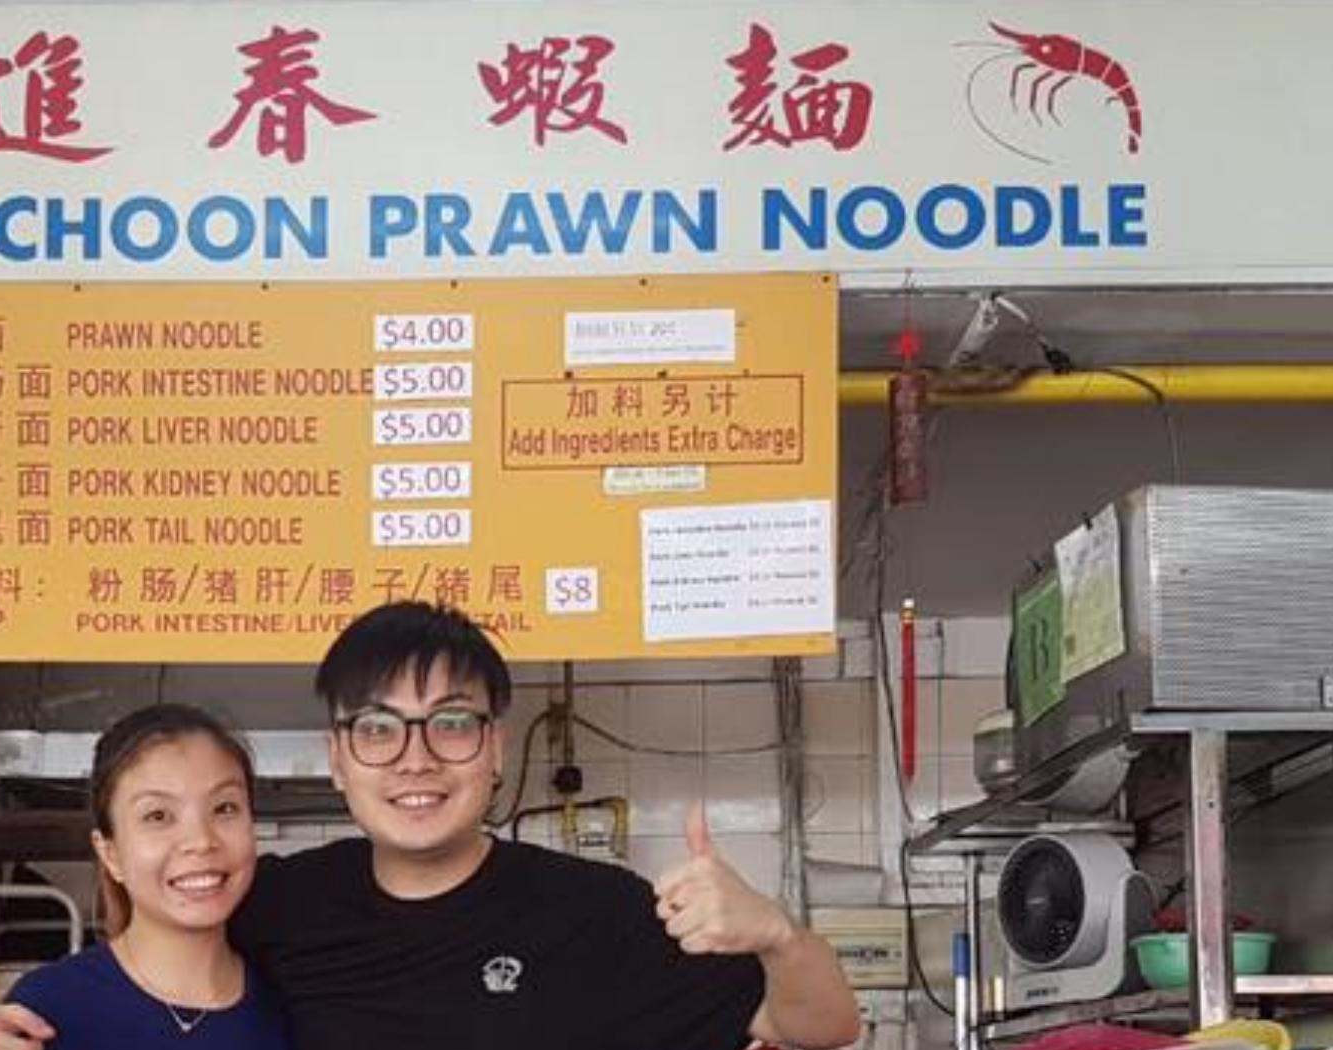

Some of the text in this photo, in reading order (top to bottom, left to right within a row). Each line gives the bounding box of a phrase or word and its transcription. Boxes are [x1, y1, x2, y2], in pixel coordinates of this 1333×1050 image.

[369, 188, 718, 259] PRAWN
[762, 183, 1148, 251] NOODLE
[66, 320, 264, 350] PRAWN NOODLE
[383, 318, 465, 350] $4.00
[67, 367, 374, 399] PORK INTESTINE NOODLE
[383, 365, 466, 396] $5.00
[565, 382, 739, 419] 加料另计
[67, 415, 318, 445] PORK LIVER NOODLE
[380, 412, 464, 443] $5.00
[507, 423, 797, 460] Add Ingredients Extra Charge
[67, 468, 341, 498] PORK KIDNEY NOODLE
[378, 465, 462, 496] $5.00
[67, 515, 303, 547] PORK TAIL NOODLE
[379, 512, 463, 543] $5.00
[553, 574, 594, 609] $8
[76, 612, 144, 633] PORK
